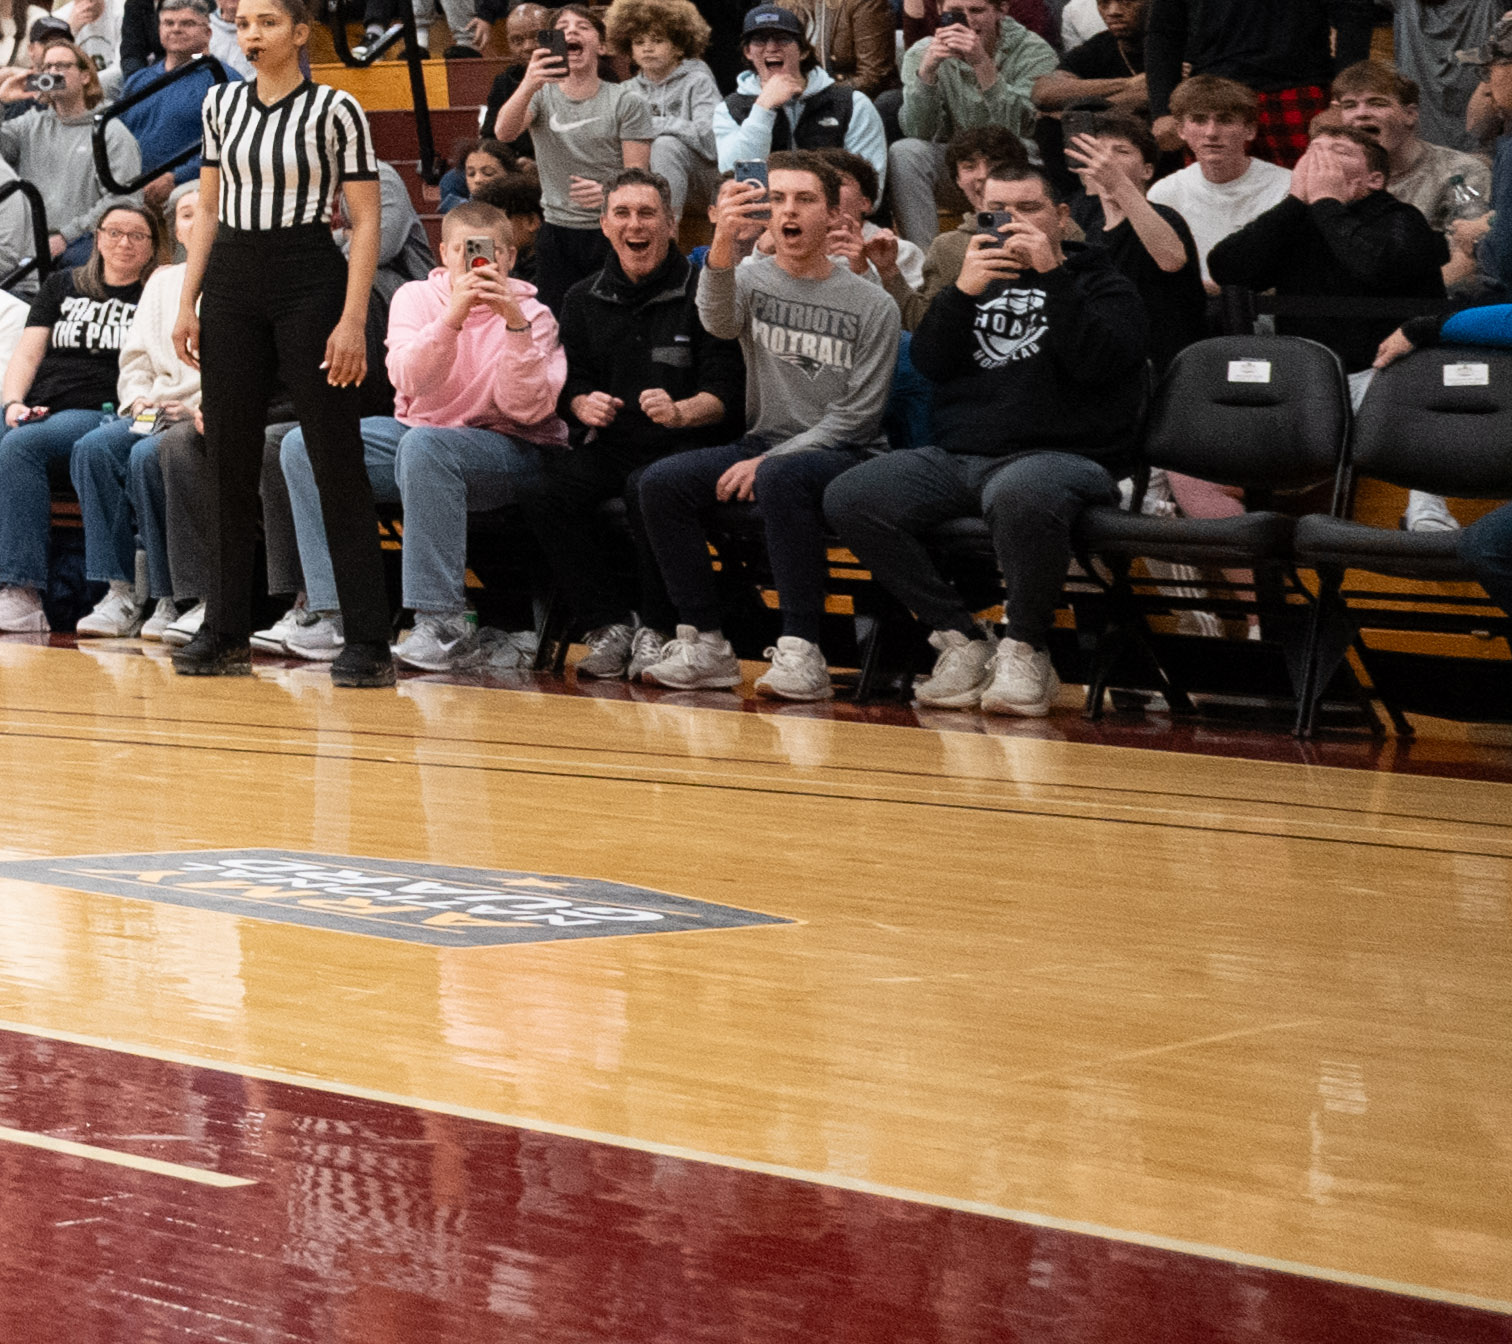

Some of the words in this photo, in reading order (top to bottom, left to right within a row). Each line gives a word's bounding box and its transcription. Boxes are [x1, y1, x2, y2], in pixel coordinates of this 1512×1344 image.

[52, 320, 83, 349] THE
[752, 292, 857, 340] PATRIOTS
[66, 866, 546, 928] ARMY
[178, 862, 604, 927] NATIONAL
[218, 859, 664, 922] GUARD
